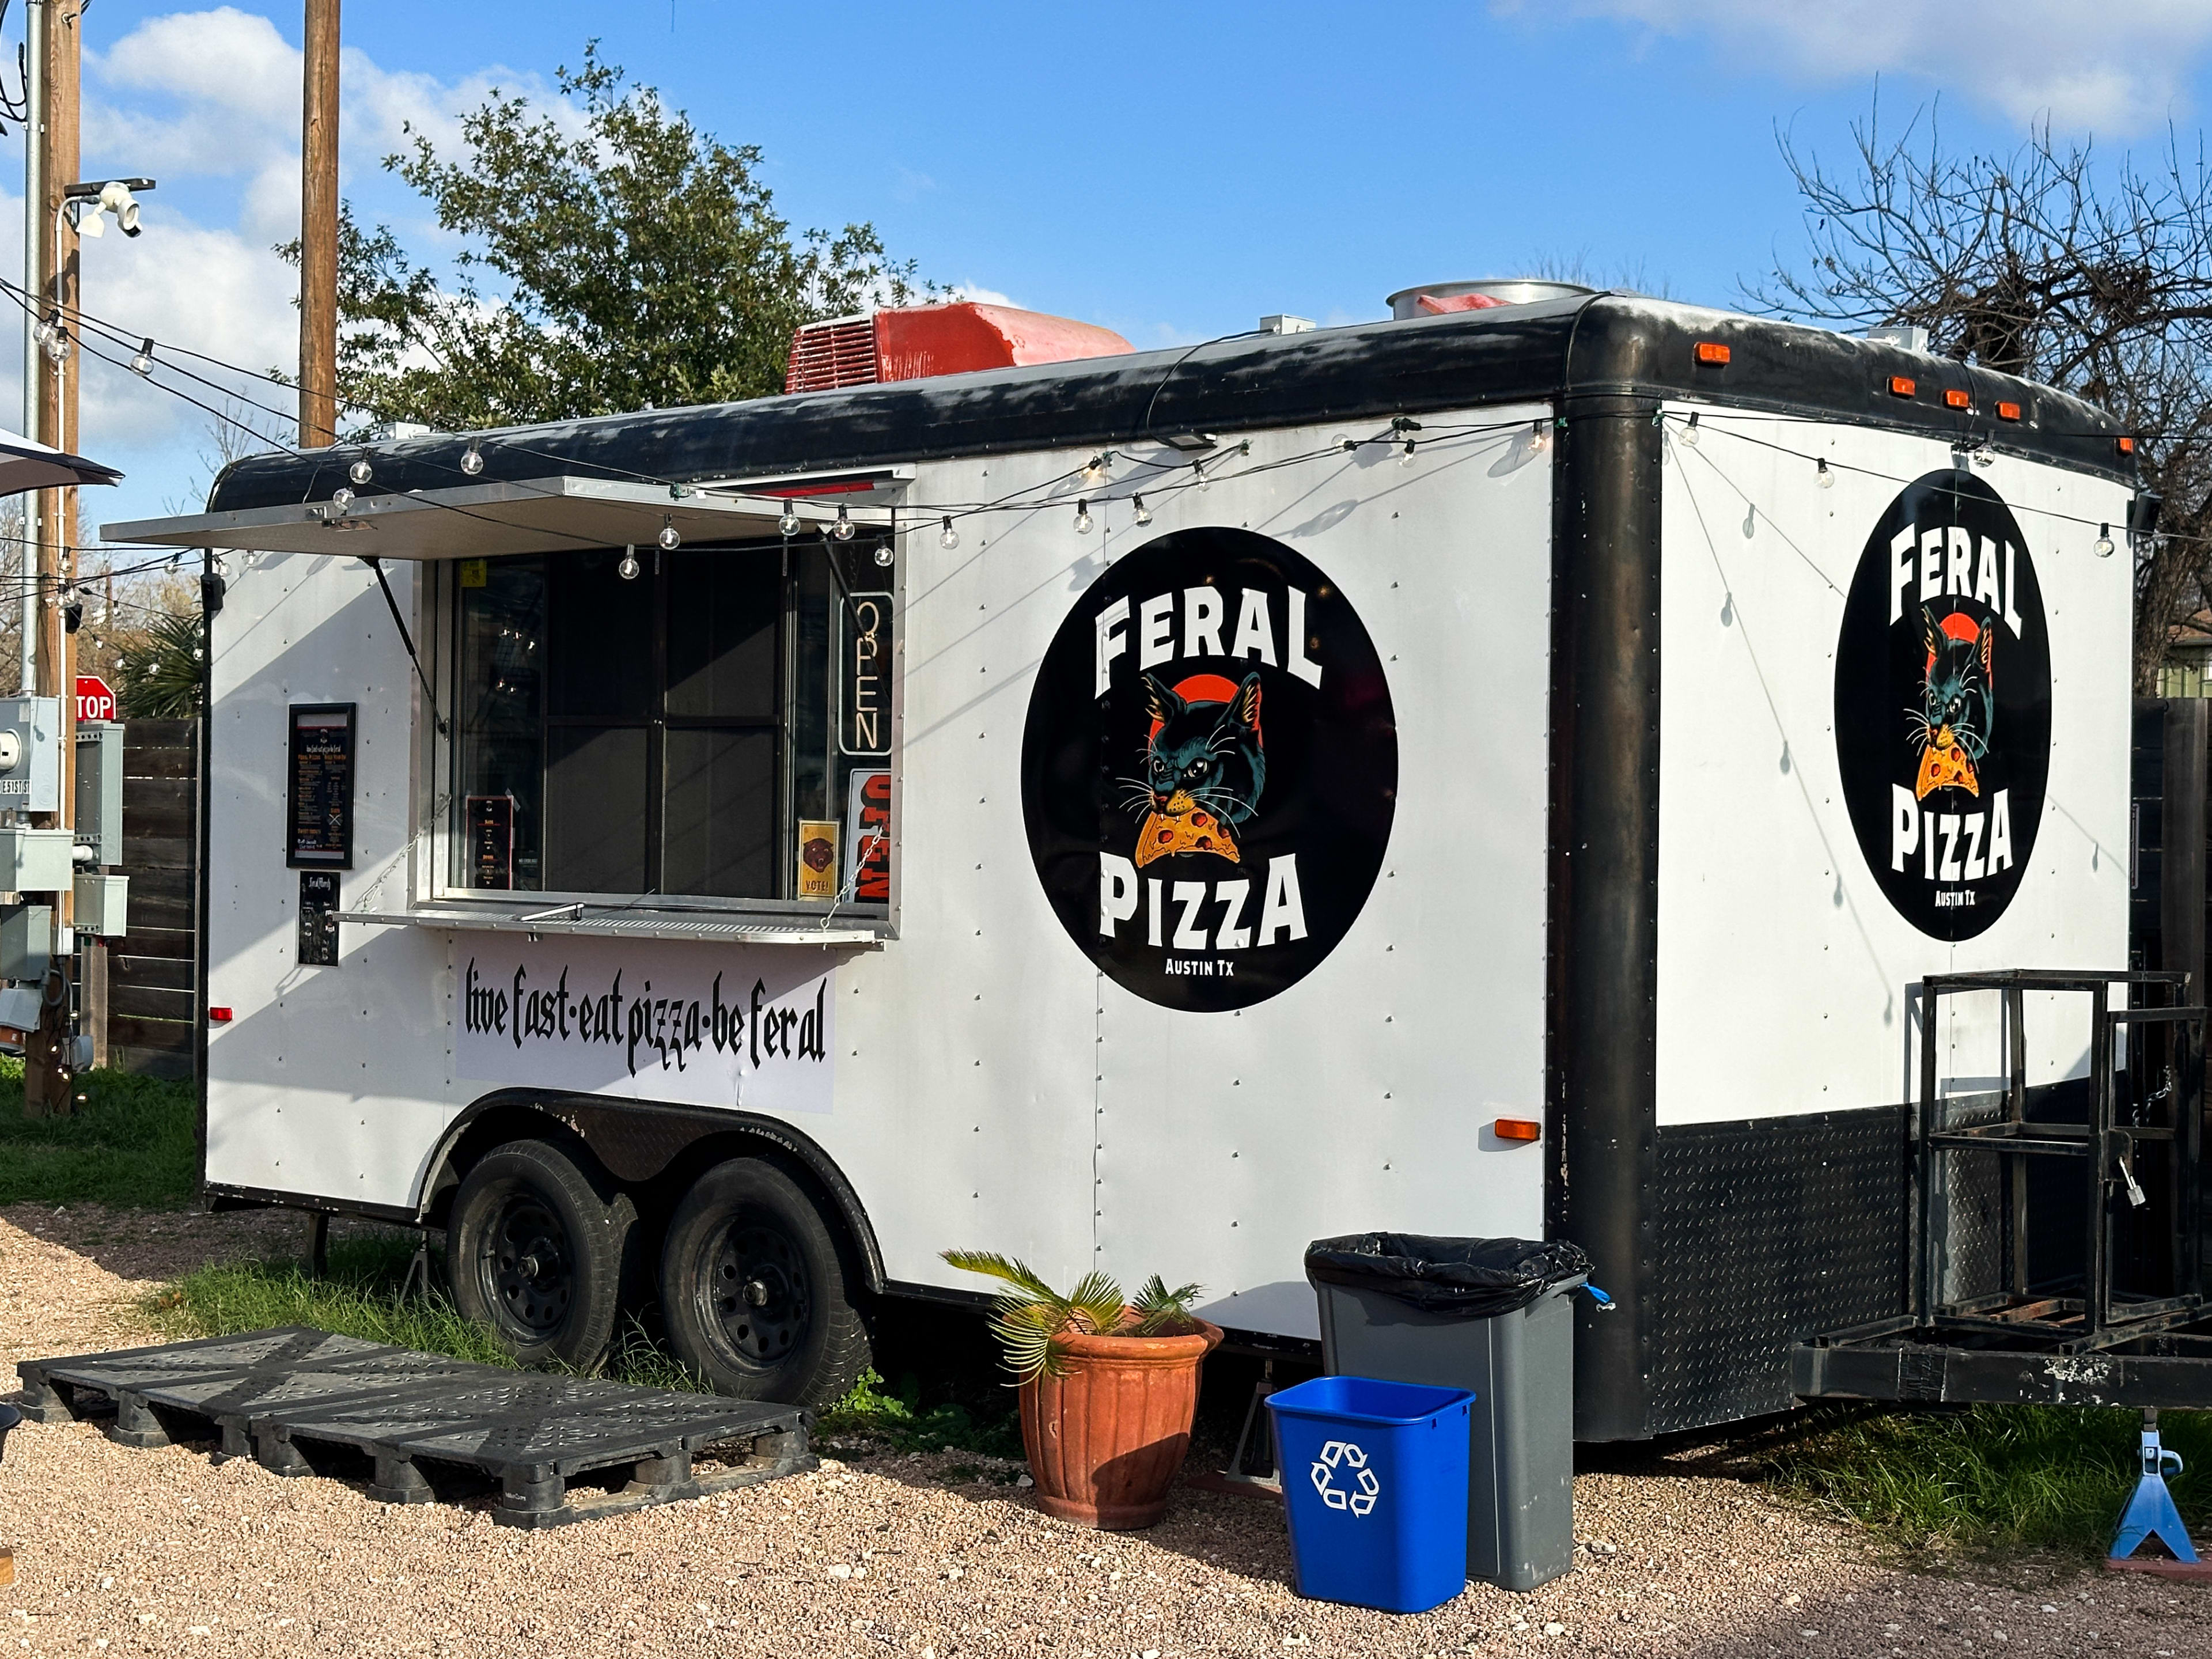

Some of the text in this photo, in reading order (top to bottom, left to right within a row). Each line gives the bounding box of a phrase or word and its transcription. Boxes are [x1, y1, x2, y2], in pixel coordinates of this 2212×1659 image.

[1889, 522, 2022, 639] FERAL
[856, 601, 879, 749] OPEN
[1095, 585, 1323, 699] FERAL
[75, 696, 111, 718] TOP
[1892, 783, 2013, 881] PIZZA
[805, 880, 828, 892] VOTE!
[1099, 852, 1308, 950] PIZZA
[465, 957, 508, 1035] live
[749, 976, 827, 1069] feral
